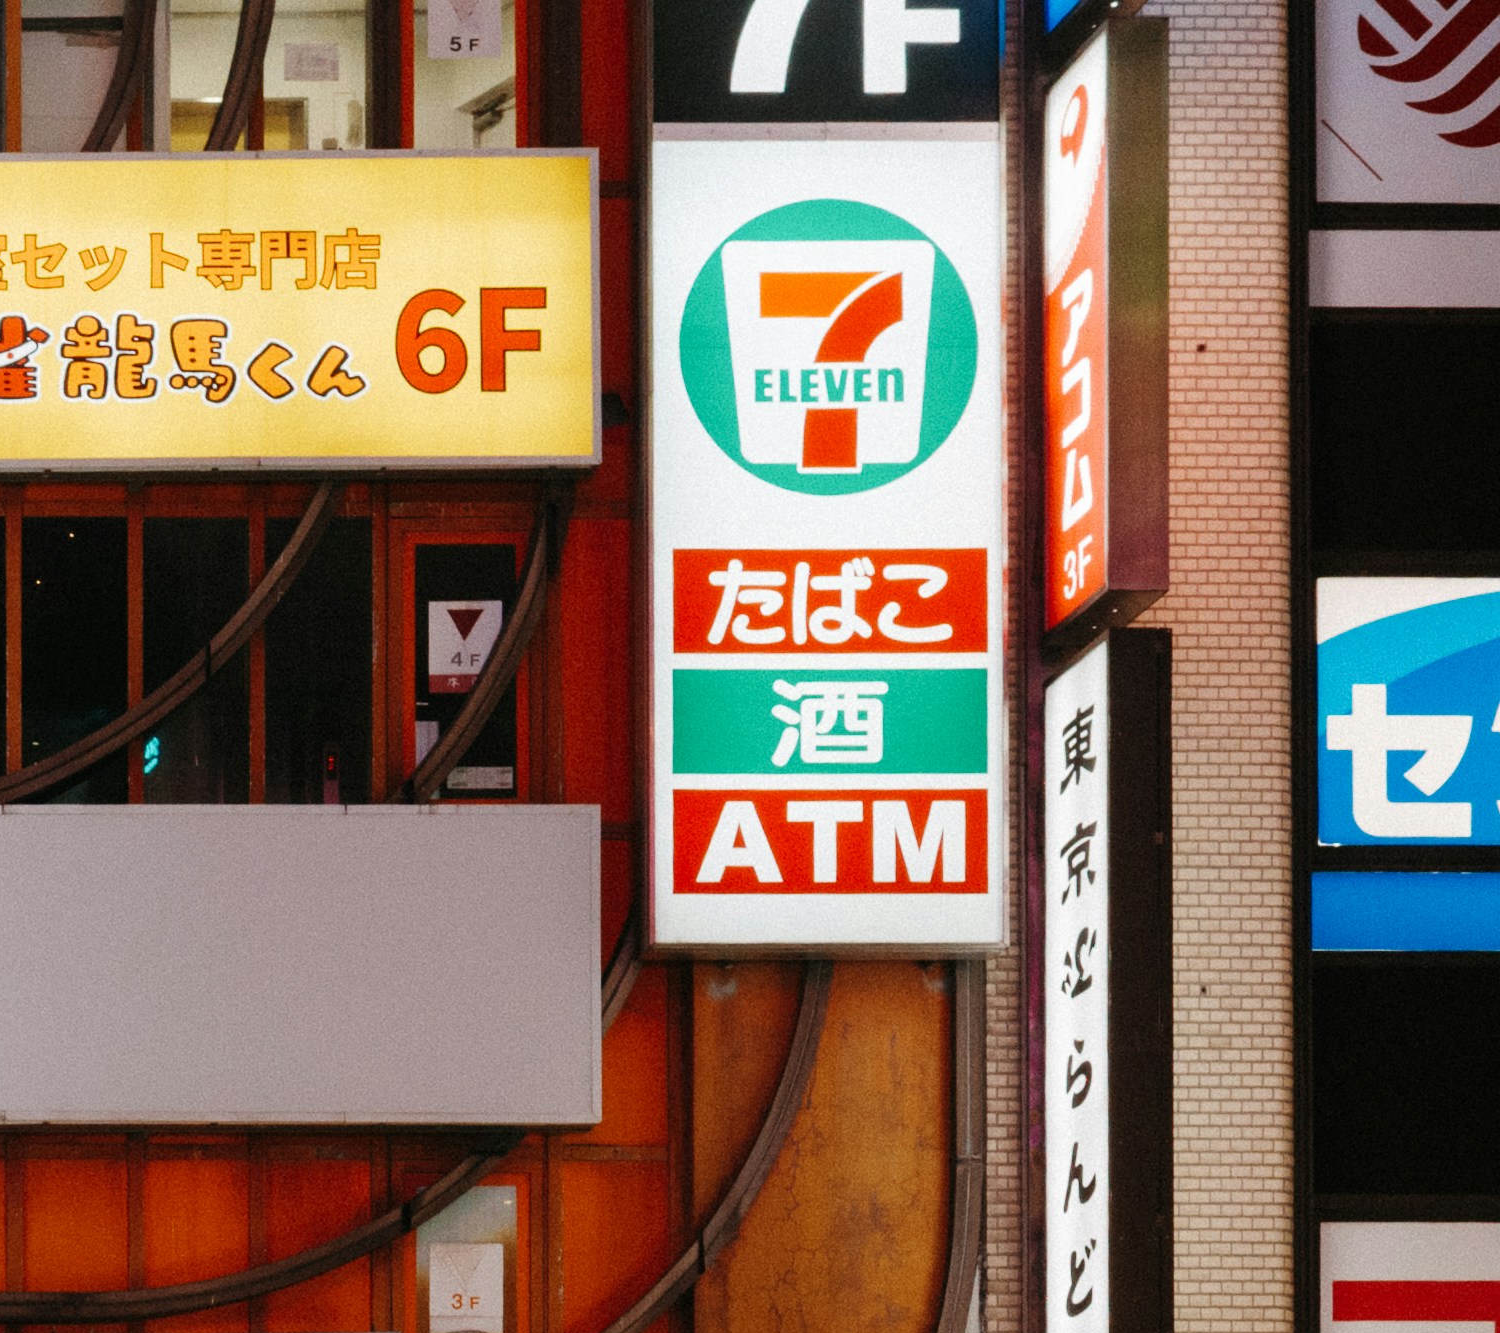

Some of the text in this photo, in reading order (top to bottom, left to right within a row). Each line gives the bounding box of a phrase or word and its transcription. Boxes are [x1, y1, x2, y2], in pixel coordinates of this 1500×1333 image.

[394, 286, 548, 395] 6F
[1061, 267, 1093, 532] アコム
[707, 556, 954, 645] たばこ
[770, 678, 890, 768] 酒
[695, 800, 968, 884] ATM
